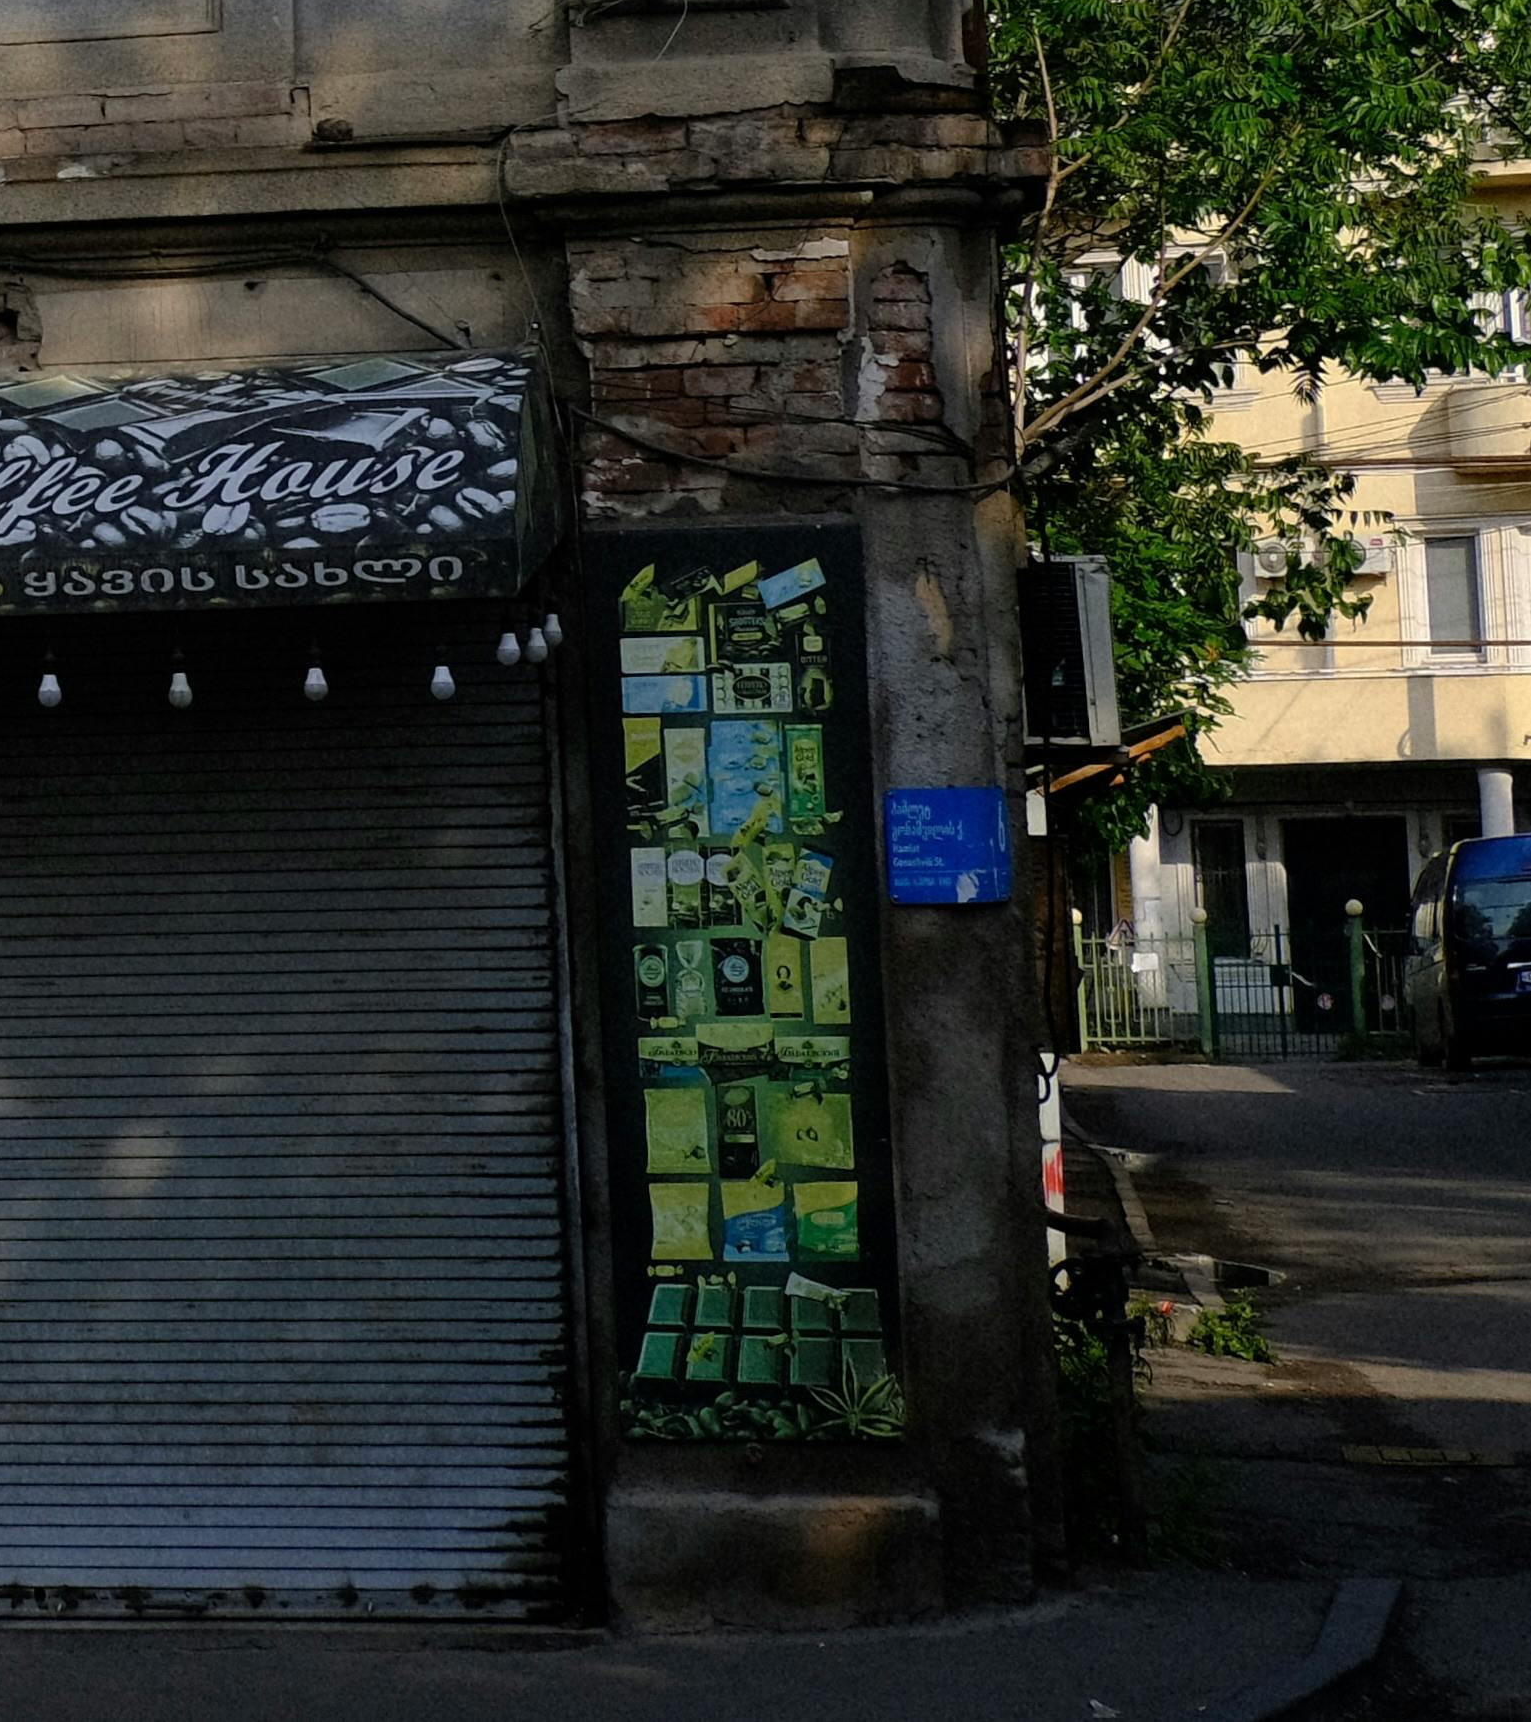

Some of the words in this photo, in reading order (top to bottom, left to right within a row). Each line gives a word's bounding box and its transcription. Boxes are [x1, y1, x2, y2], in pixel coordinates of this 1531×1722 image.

[162, 438, 466, 520] House
[24, 565, 215, 598] ყავის
[235, 553, 464, 592] სახლი
